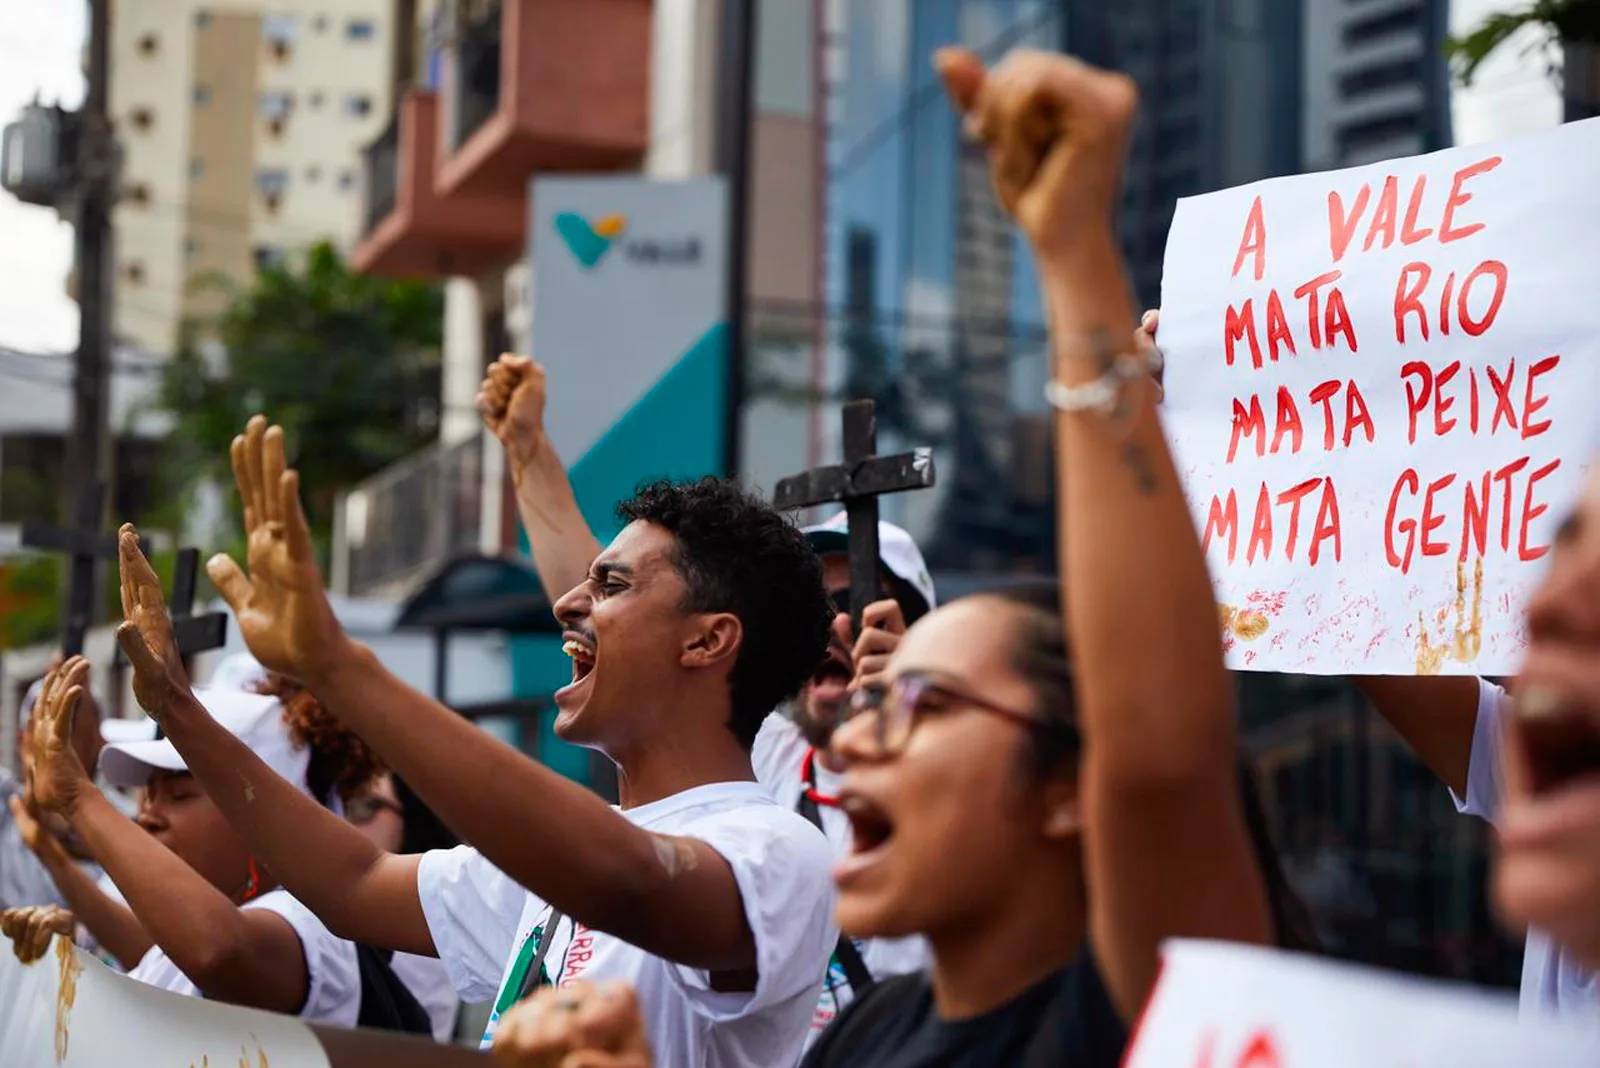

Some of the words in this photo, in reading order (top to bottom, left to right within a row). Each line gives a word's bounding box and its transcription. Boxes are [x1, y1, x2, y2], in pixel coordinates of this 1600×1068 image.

[1232, 196, 1266, 281] A
[1327, 155, 1502, 263] VALE
[1223, 270, 1359, 370] MATA
[1393, 259, 1508, 346] RIO
[1226, 379, 1376, 464] MATA
[1399, 355, 1561, 445] PEIXE
[1203, 475, 1343, 568] MATA
[1383, 456, 1561, 576] GENTE
